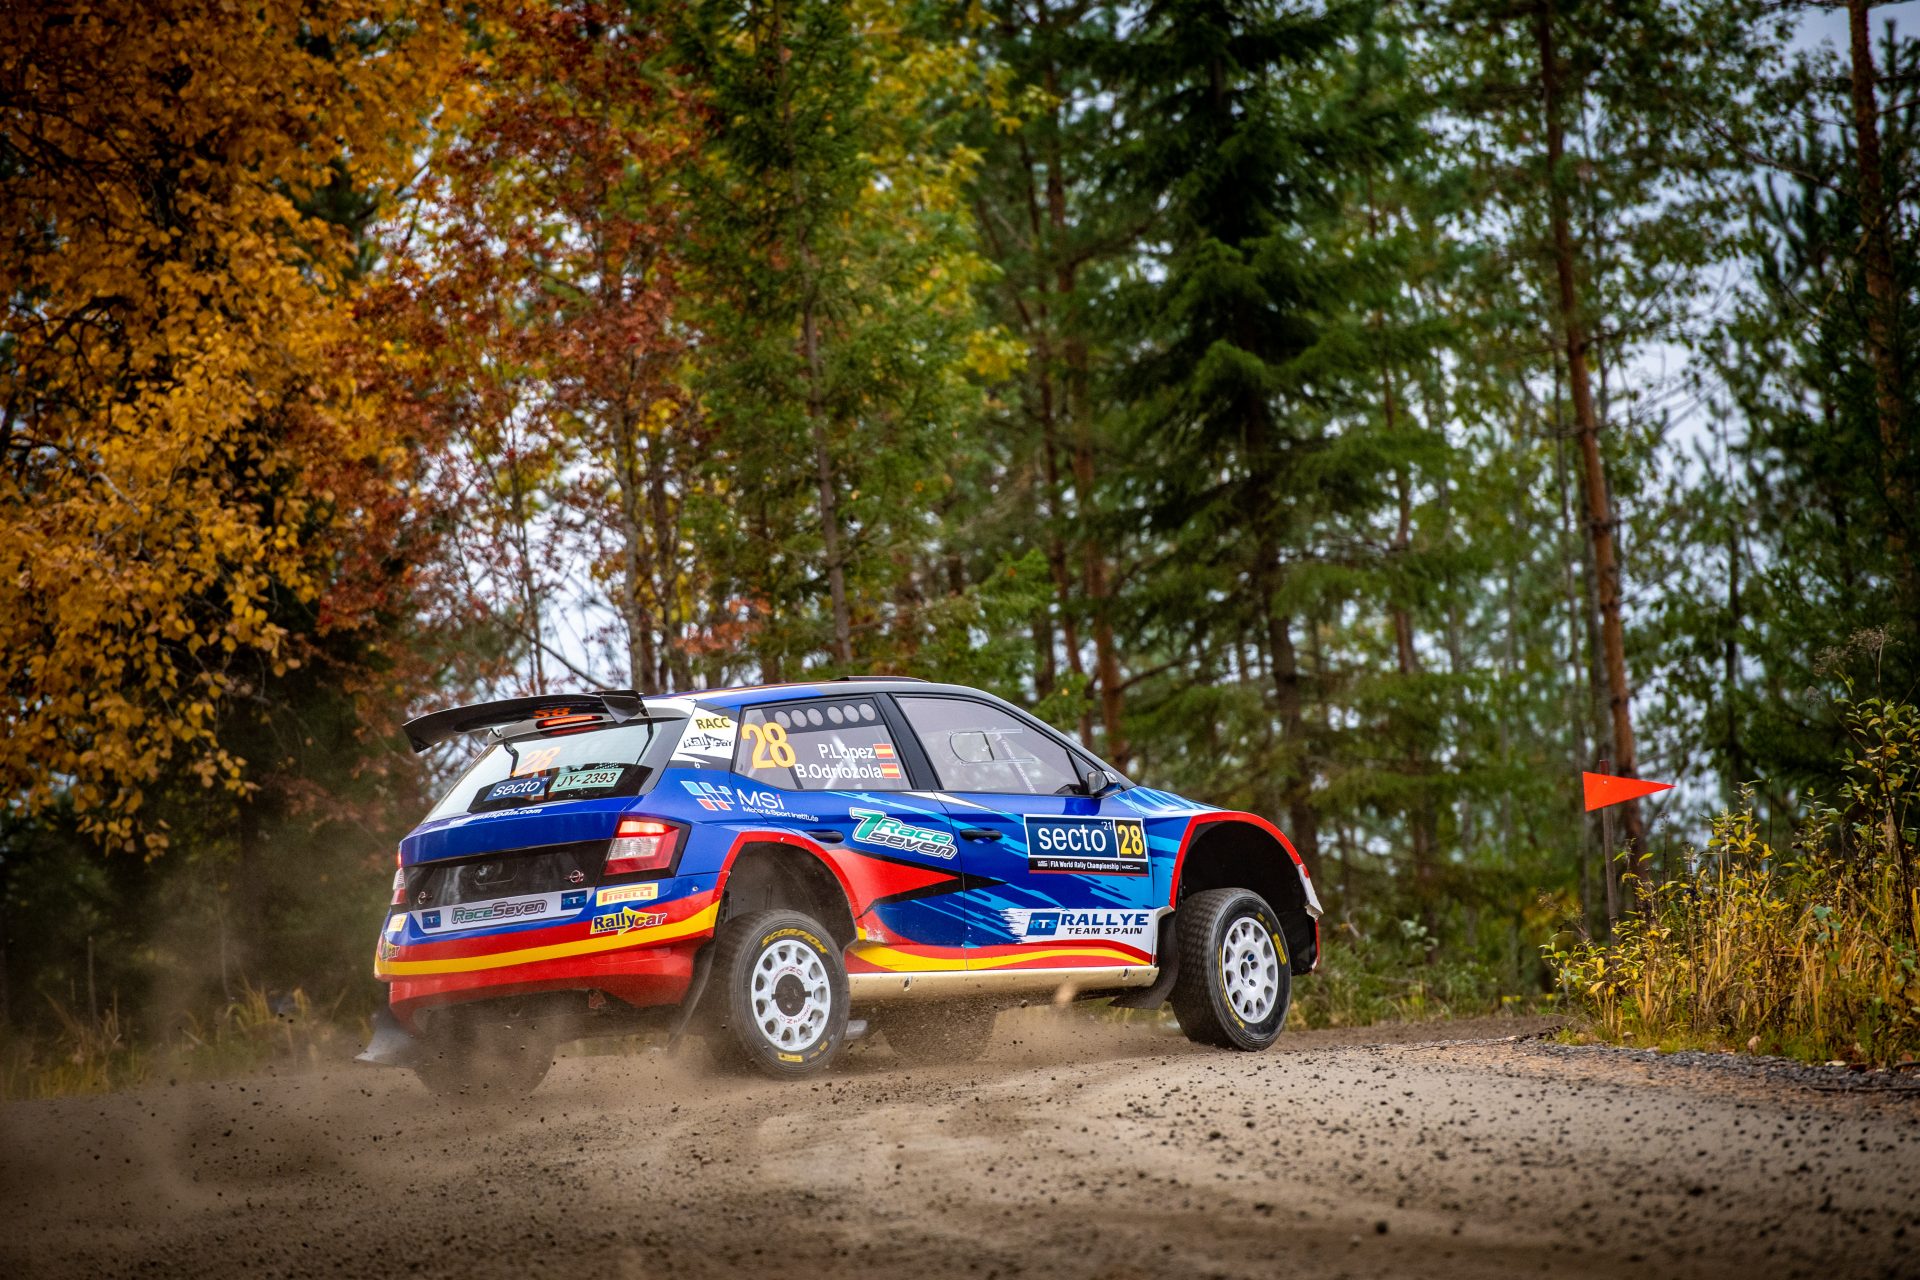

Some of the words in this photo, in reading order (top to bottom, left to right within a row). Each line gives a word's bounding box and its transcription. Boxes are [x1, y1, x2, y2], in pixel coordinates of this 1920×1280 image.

[695, 717, 731, 730] RACC
[741, 722, 796, 769] 28
[512, 746, 562, 777] 28
[795, 762, 884, 779] B.Odriozola
[557, 772, 617, 788] JY-2393
[492, 781, 541, 797] secto
[742, 806, 764, 814] Motor
[771, 809, 791, 818] Sport
[791, 812, 819, 822] Institute
[874, 819, 952, 845] Race
[1038, 824, 1107, 852] secto
[1117, 824, 1143, 855] 28
[1074, 861, 1086, 870] Rally
[1086, 862, 1119, 871] Championship
[562, 895, 587, 905] RTS
[602, 886, 653, 903] PIRELLI
[593, 912, 667, 930] Rallycar
[1029, 919, 1058, 929] RTS
[1060, 913, 1150, 926] RALLYE
[1067, 927, 1100, 935] TEAM
[1104, 927, 1143, 935] SPAIN
